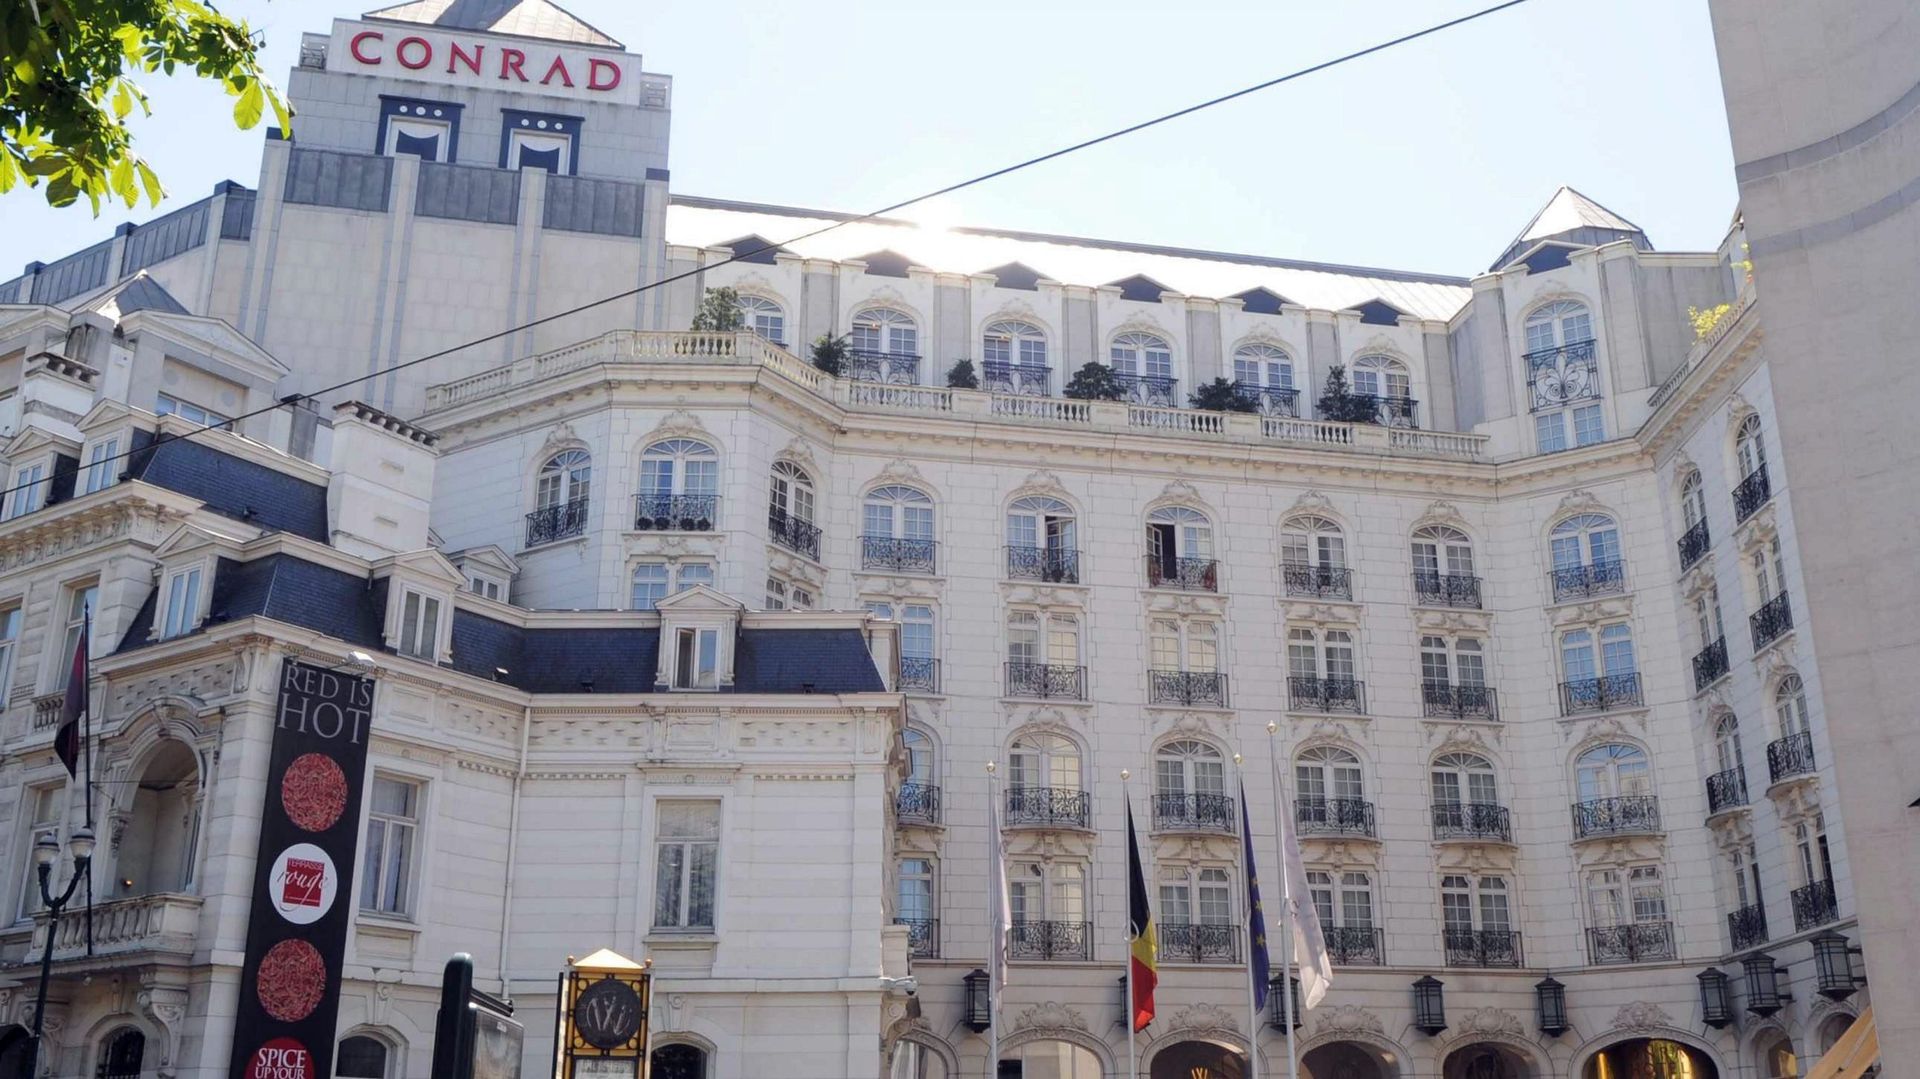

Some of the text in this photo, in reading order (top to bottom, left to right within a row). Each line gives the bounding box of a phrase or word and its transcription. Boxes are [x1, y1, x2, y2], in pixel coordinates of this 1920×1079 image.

[350, 31, 622, 91] CONRAD
[284, 664, 372, 707] RED IS
[277, 692, 370, 744] HOT
[277, 870, 329, 912] rouge
[254, 1066, 305, 1079] UP YOUR
[257, 1047, 307, 1069] SPICE
